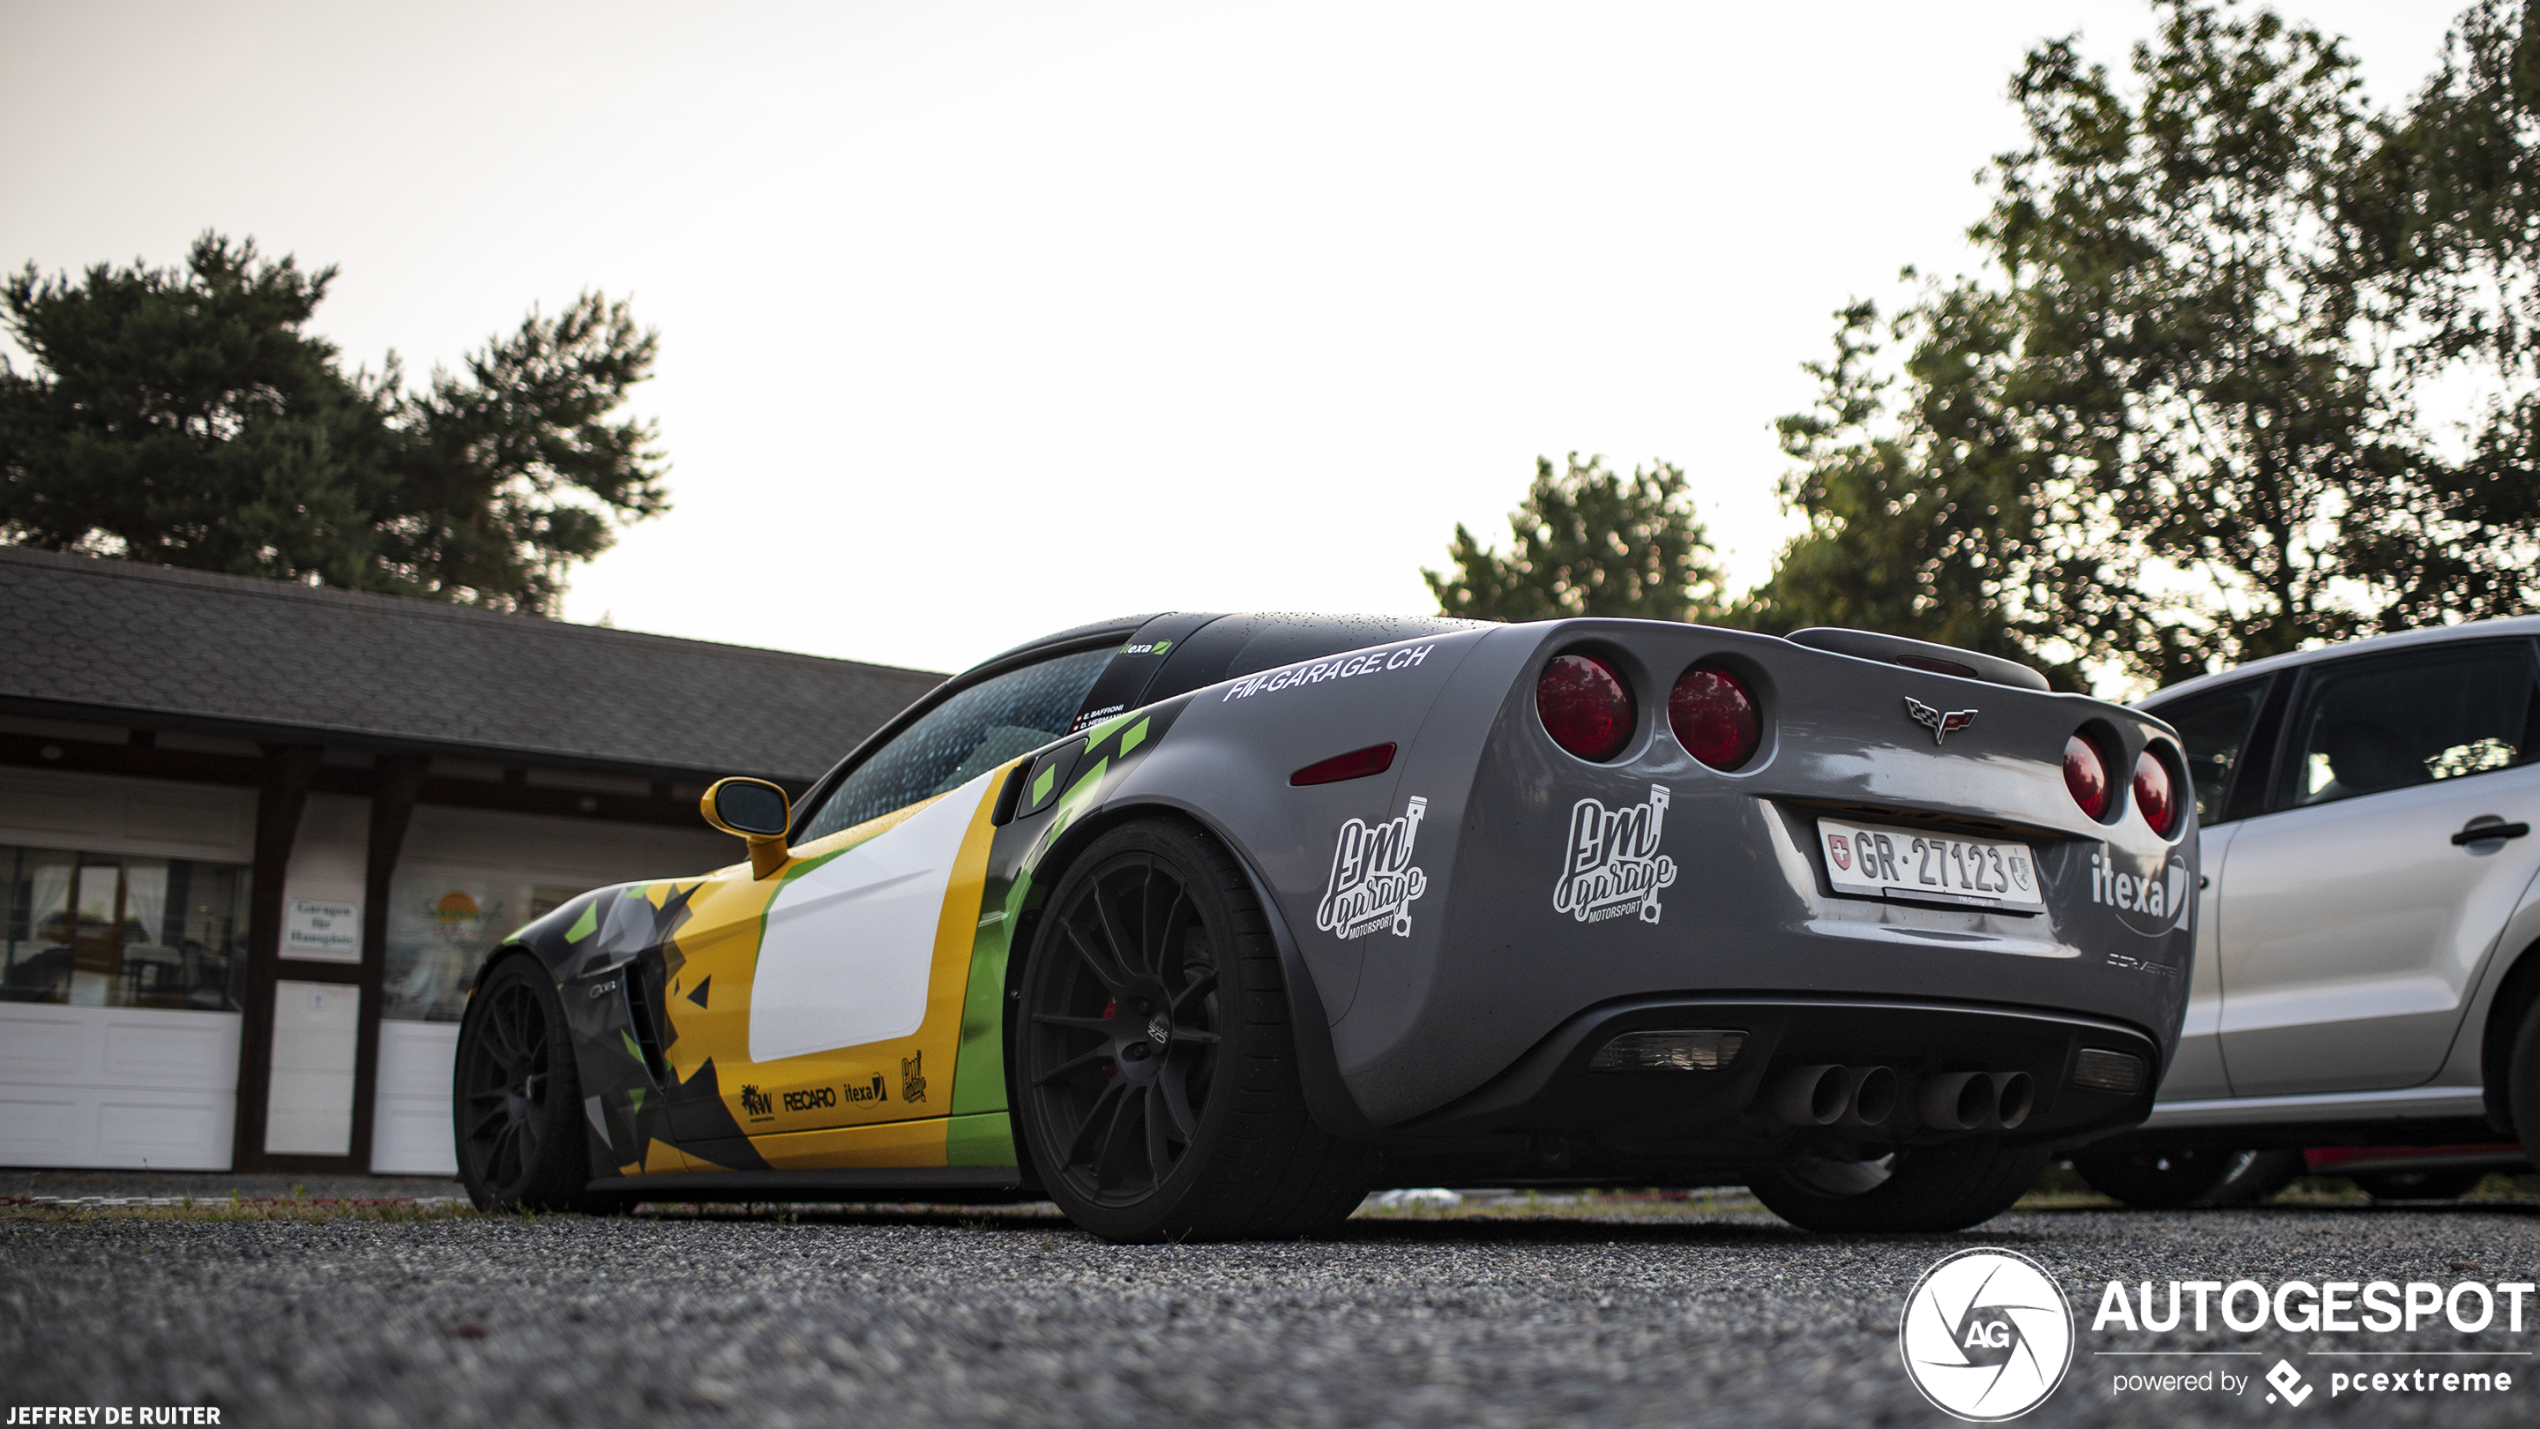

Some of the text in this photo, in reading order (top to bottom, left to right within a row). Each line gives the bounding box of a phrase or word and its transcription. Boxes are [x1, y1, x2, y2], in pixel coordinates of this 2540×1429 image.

[1222, 644, 1435, 702] FM-GARAGE.CH
[1090, 704, 1124, 718] BAFFIONI
[2092, 853, 2164, 917] itexa
[1588, 900, 1642, 924] MOTORSPORT
[1349, 914, 1394, 940] MOTORSPORT
[783, 1087, 836, 1112] RECARO
[844, 1083, 874, 1102] itexa
